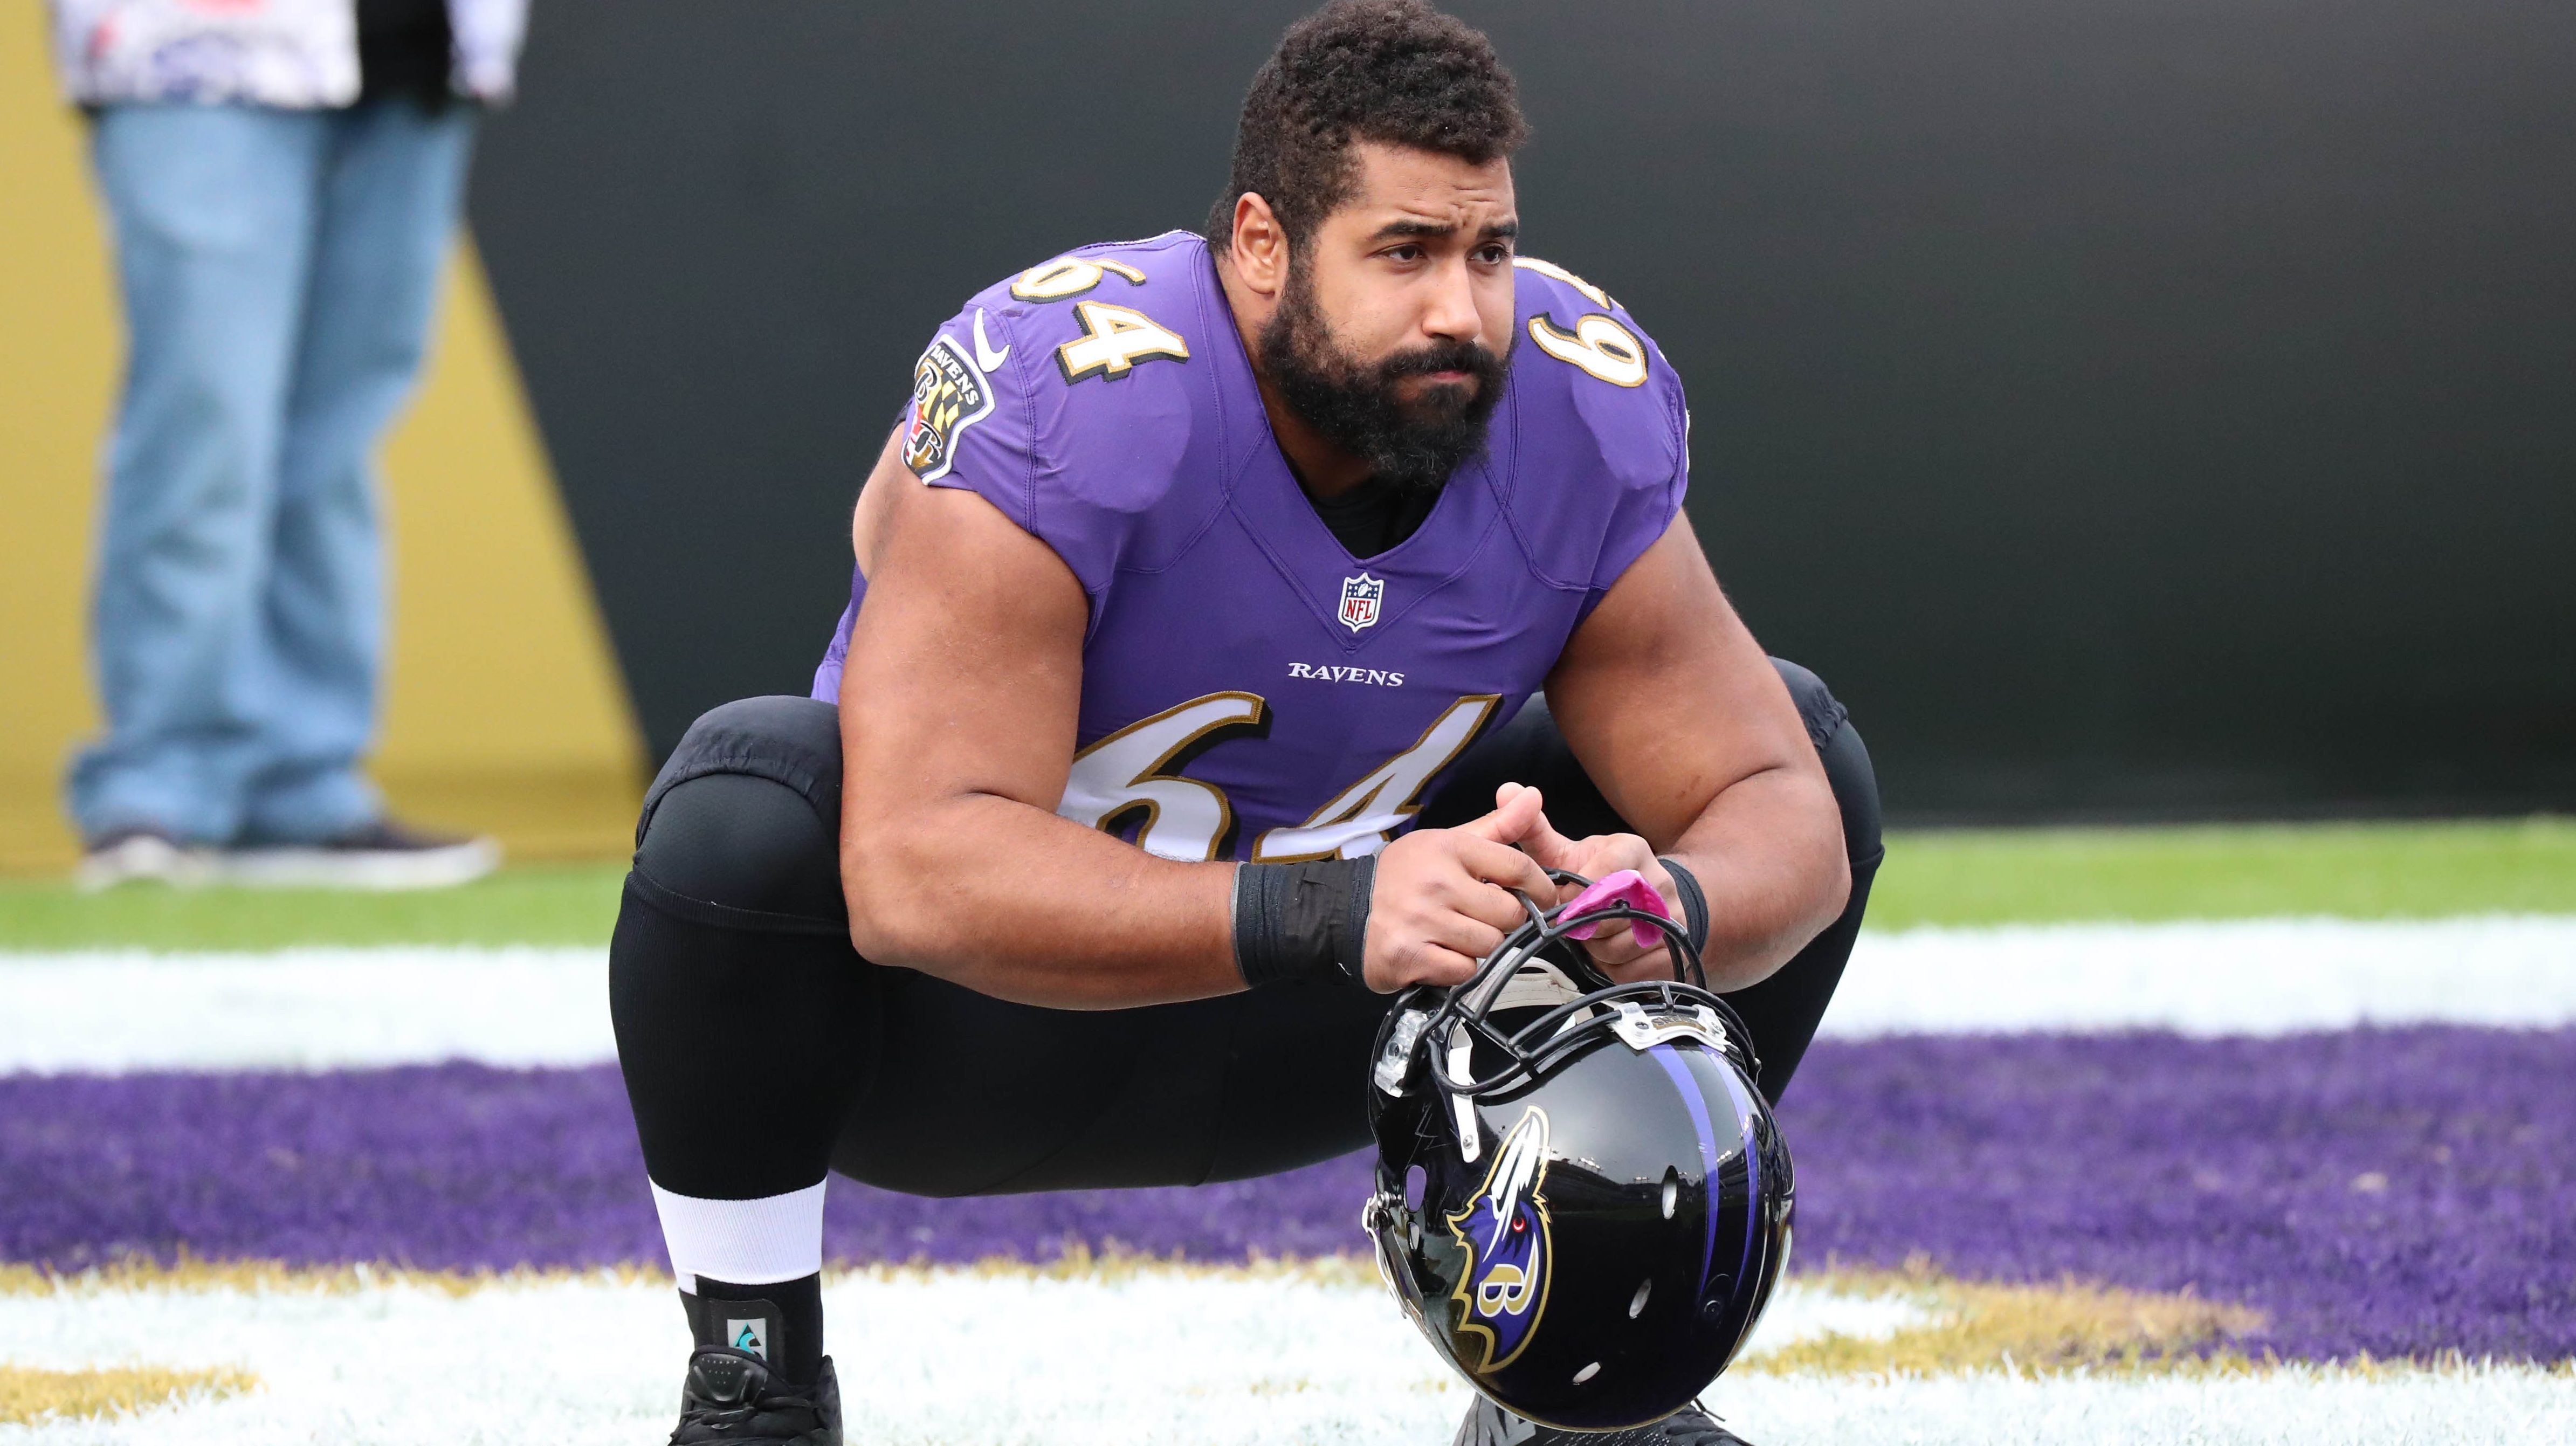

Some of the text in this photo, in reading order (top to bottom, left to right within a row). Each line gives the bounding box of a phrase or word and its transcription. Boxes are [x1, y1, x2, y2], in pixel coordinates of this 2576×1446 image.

[1010, 256, 1190, 386] 64
[1345, 599, 1372, 621] NFL
[1288, 663, 1405, 687] RAVENS
[1056, 690, 1503, 863] 64
[1477, 1232, 1539, 1318] B
